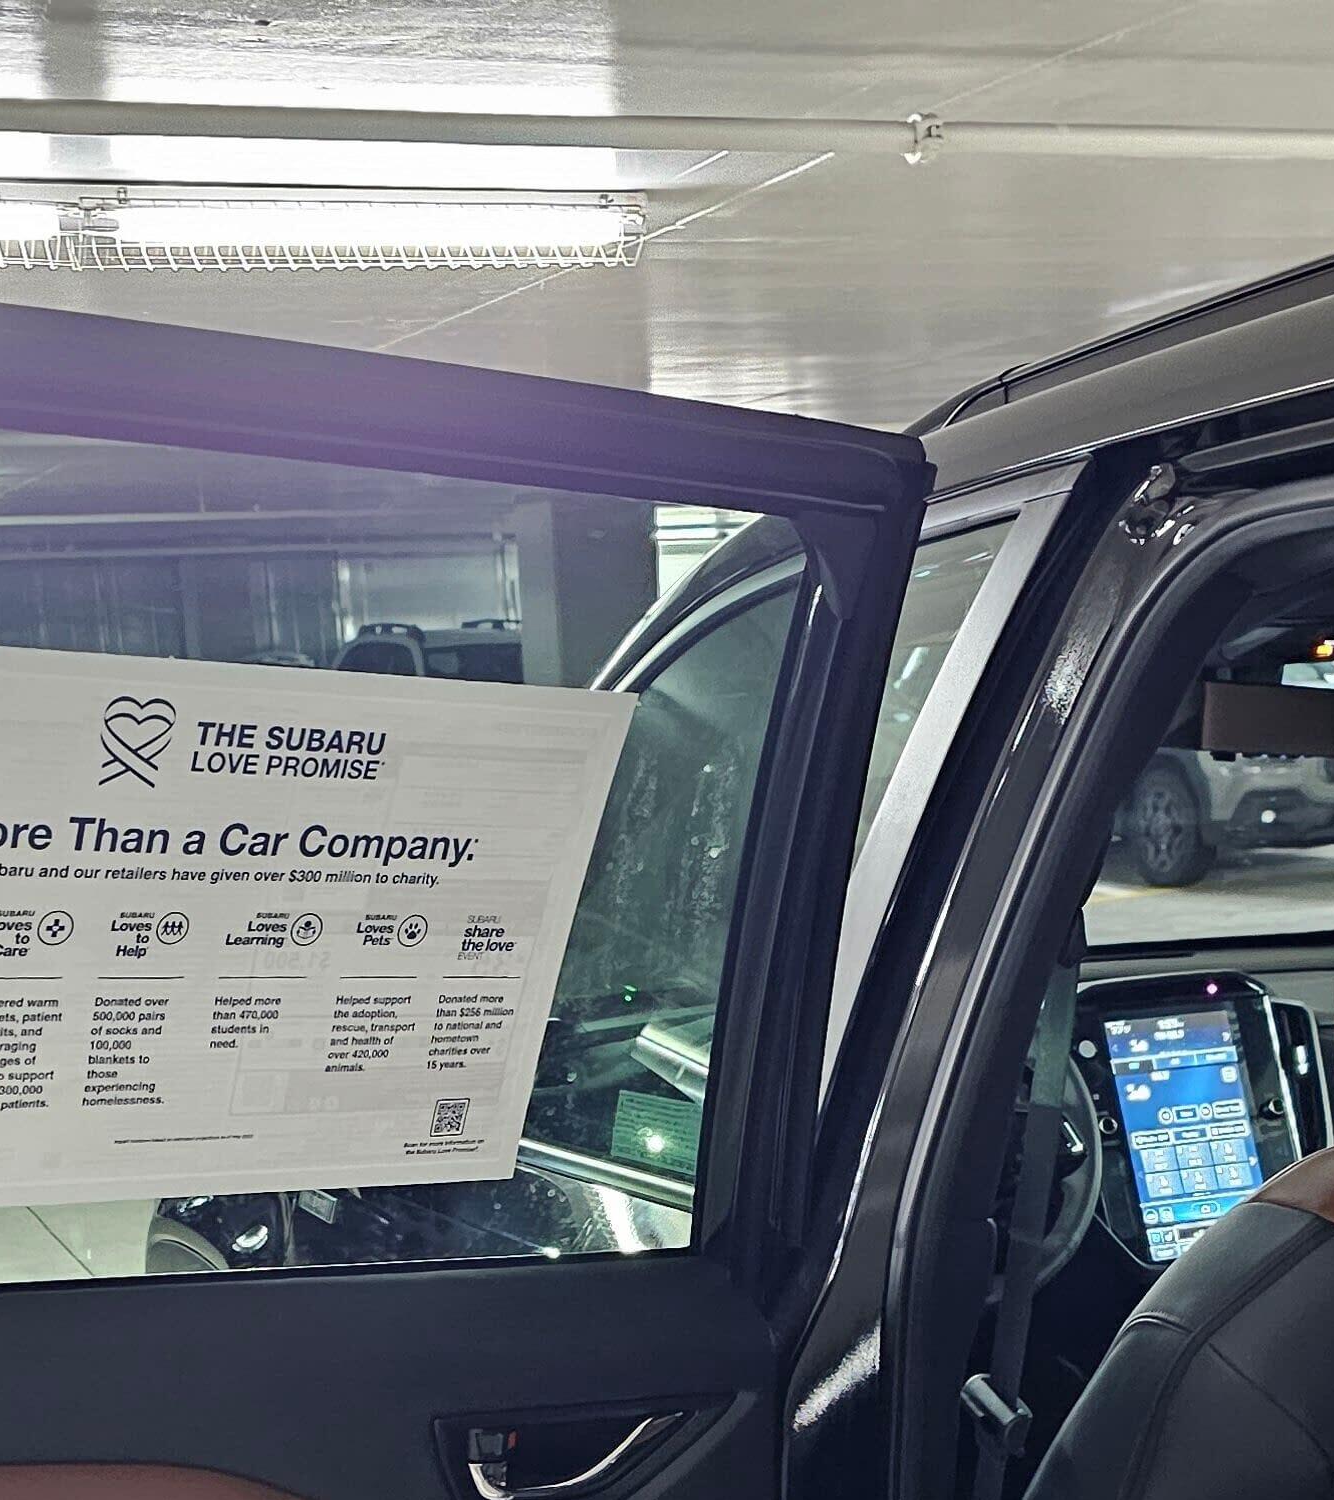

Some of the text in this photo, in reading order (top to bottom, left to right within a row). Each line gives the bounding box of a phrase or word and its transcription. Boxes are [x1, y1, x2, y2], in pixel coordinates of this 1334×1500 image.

[198, 722, 386, 755] THE SUBARU
[191, 751, 380, 780] LOVE PROMISE
[70, 817, 169, 854] Than
[183, 831, 205, 855] a
[220, 823, 289, 856] Car
[299, 825, 473, 867] Company.
[39, 866, 69, 878] and
[74, 869, 101, 878] our
[105, 867, 167, 880] retailers
[171, 868, 206, 881] have
[210, 869, 249, 884] given
[254, 872, 285, 881] over
[289, 870, 321, 882] $300
[325, 871, 371, 883] million
[376, 873, 388, 883] to
[393, 873, 439, 888] charity.
[467, 915, 500, 923] SUBARU
[111, 920, 152, 931] Loves
[248, 921, 287, 932] Loves
[357, 922, 394, 933] Loves
[464, 925, 505, 937] share
[16, 933, 30, 944] to
[136, 933, 149, 943] to
[226, 934, 285, 948] Learning
[363, 935, 391, 945] Pets
[462, 939, 514, 951] the love
[116, 945, 146, 959] Help
[95, 997, 141, 1006] Donated
[215, 997, 252, 1007] Helped
[336, 996, 411, 1006] Helped support
[439, 994, 478, 1004] Donated
[22, 1013, 62, 1024] patient
[93, 1011, 165, 1022] 500,000 pairs
[213, 1010, 278, 1020] than 470,000
[334, 1009, 397, 1020] the adoption,
[91, 1026, 162, 1035] of socks and
[211, 1024, 269, 1034] students in
[332, 1023, 415, 1034] rescue, transport
[446, 1021, 483, 1030] national
[485, 1021, 502, 1029] and
[21, 1027, 43, 1036] and
[210, 1039, 238, 1048] need.
[330, 1036, 394, 1046] and health of
[431, 1035, 479, 1044] hometown
[91, 1040, 131, 1051] 100,000
[352, 1049, 389, 1059] 420,000
[429, 1047, 467, 1056] charities
[24, 1056, 36, 1065] of
[89, 1054, 149, 1064] blankets to
[325, 1063, 364, 1072] animals.
[428, 1060, 466, 1071] 15 years.
[8, 1071, 54, 1082] support
[87, 1070, 117, 1079] those
[0, 1085, 43, 1095] 300,000
[84, 1082, 155, 1095] experiencing
[0, 1100, 48, 1111] patients.
[82, 1097, 165, 1106] homelessness.
